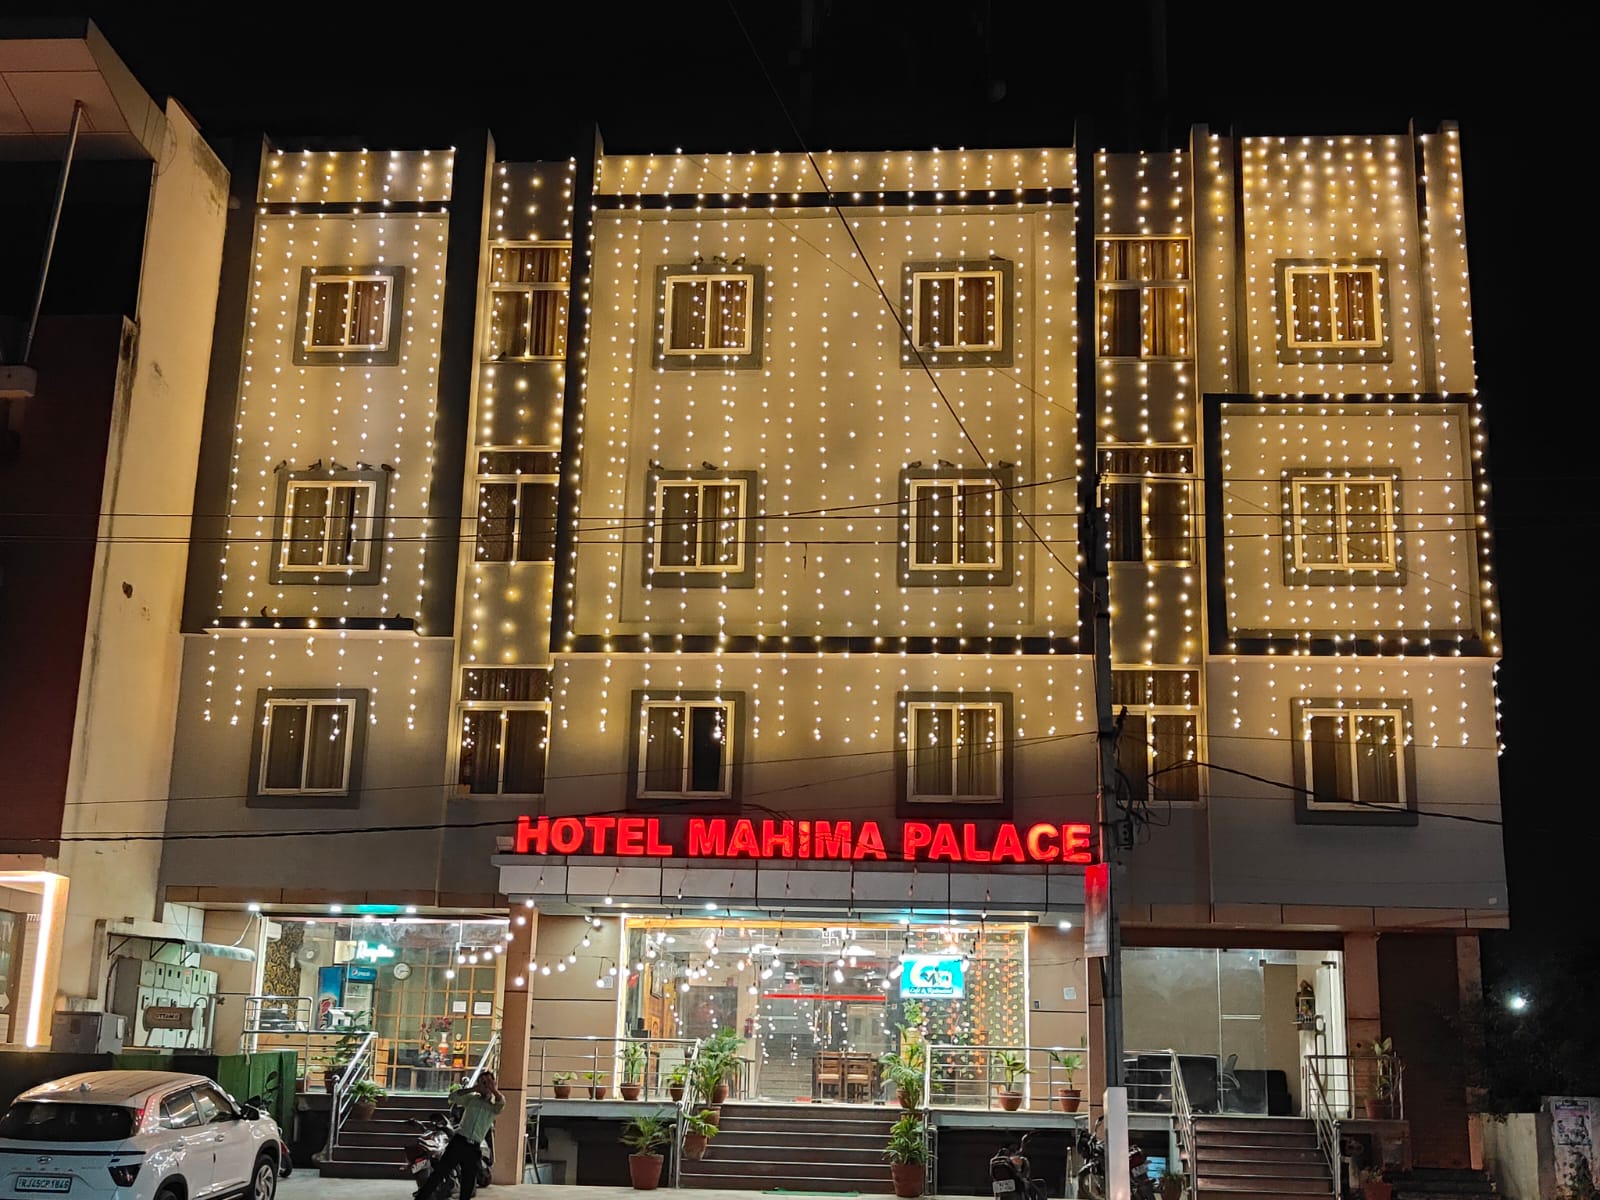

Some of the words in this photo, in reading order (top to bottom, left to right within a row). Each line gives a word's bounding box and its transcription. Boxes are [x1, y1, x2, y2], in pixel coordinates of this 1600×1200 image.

[516, 815, 672, 855] HOTEL
[688, 818, 886, 860] MAHIMA
[903, 821, 1092, 863] PALACE
